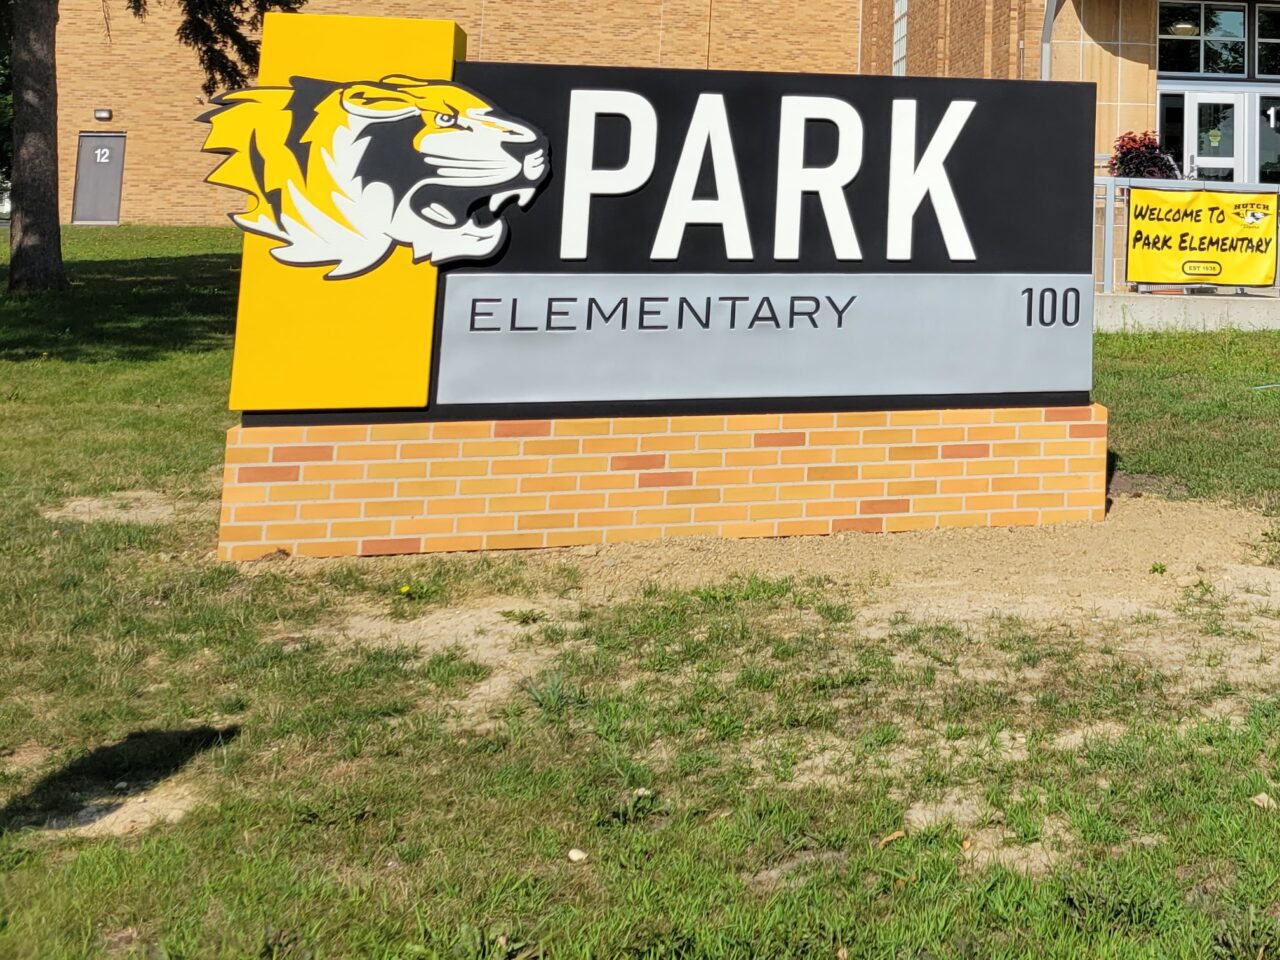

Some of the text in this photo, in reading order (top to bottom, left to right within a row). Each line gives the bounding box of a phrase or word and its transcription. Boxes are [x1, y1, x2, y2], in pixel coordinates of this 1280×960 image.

[1266, 106, 1275, 128] 1
[95, 148, 110, 162] 12
[560, 89, 977, 261] PARK
[1134, 204, 1226, 223] WELCOME TO
[1234, 202, 1269, 211] HUTCH
[1132, 229, 1272, 254] PARK ELEMENTARY
[469, 295, 857, 332] ELEMENTARY
[1022, 287, 1080, 327] 100
